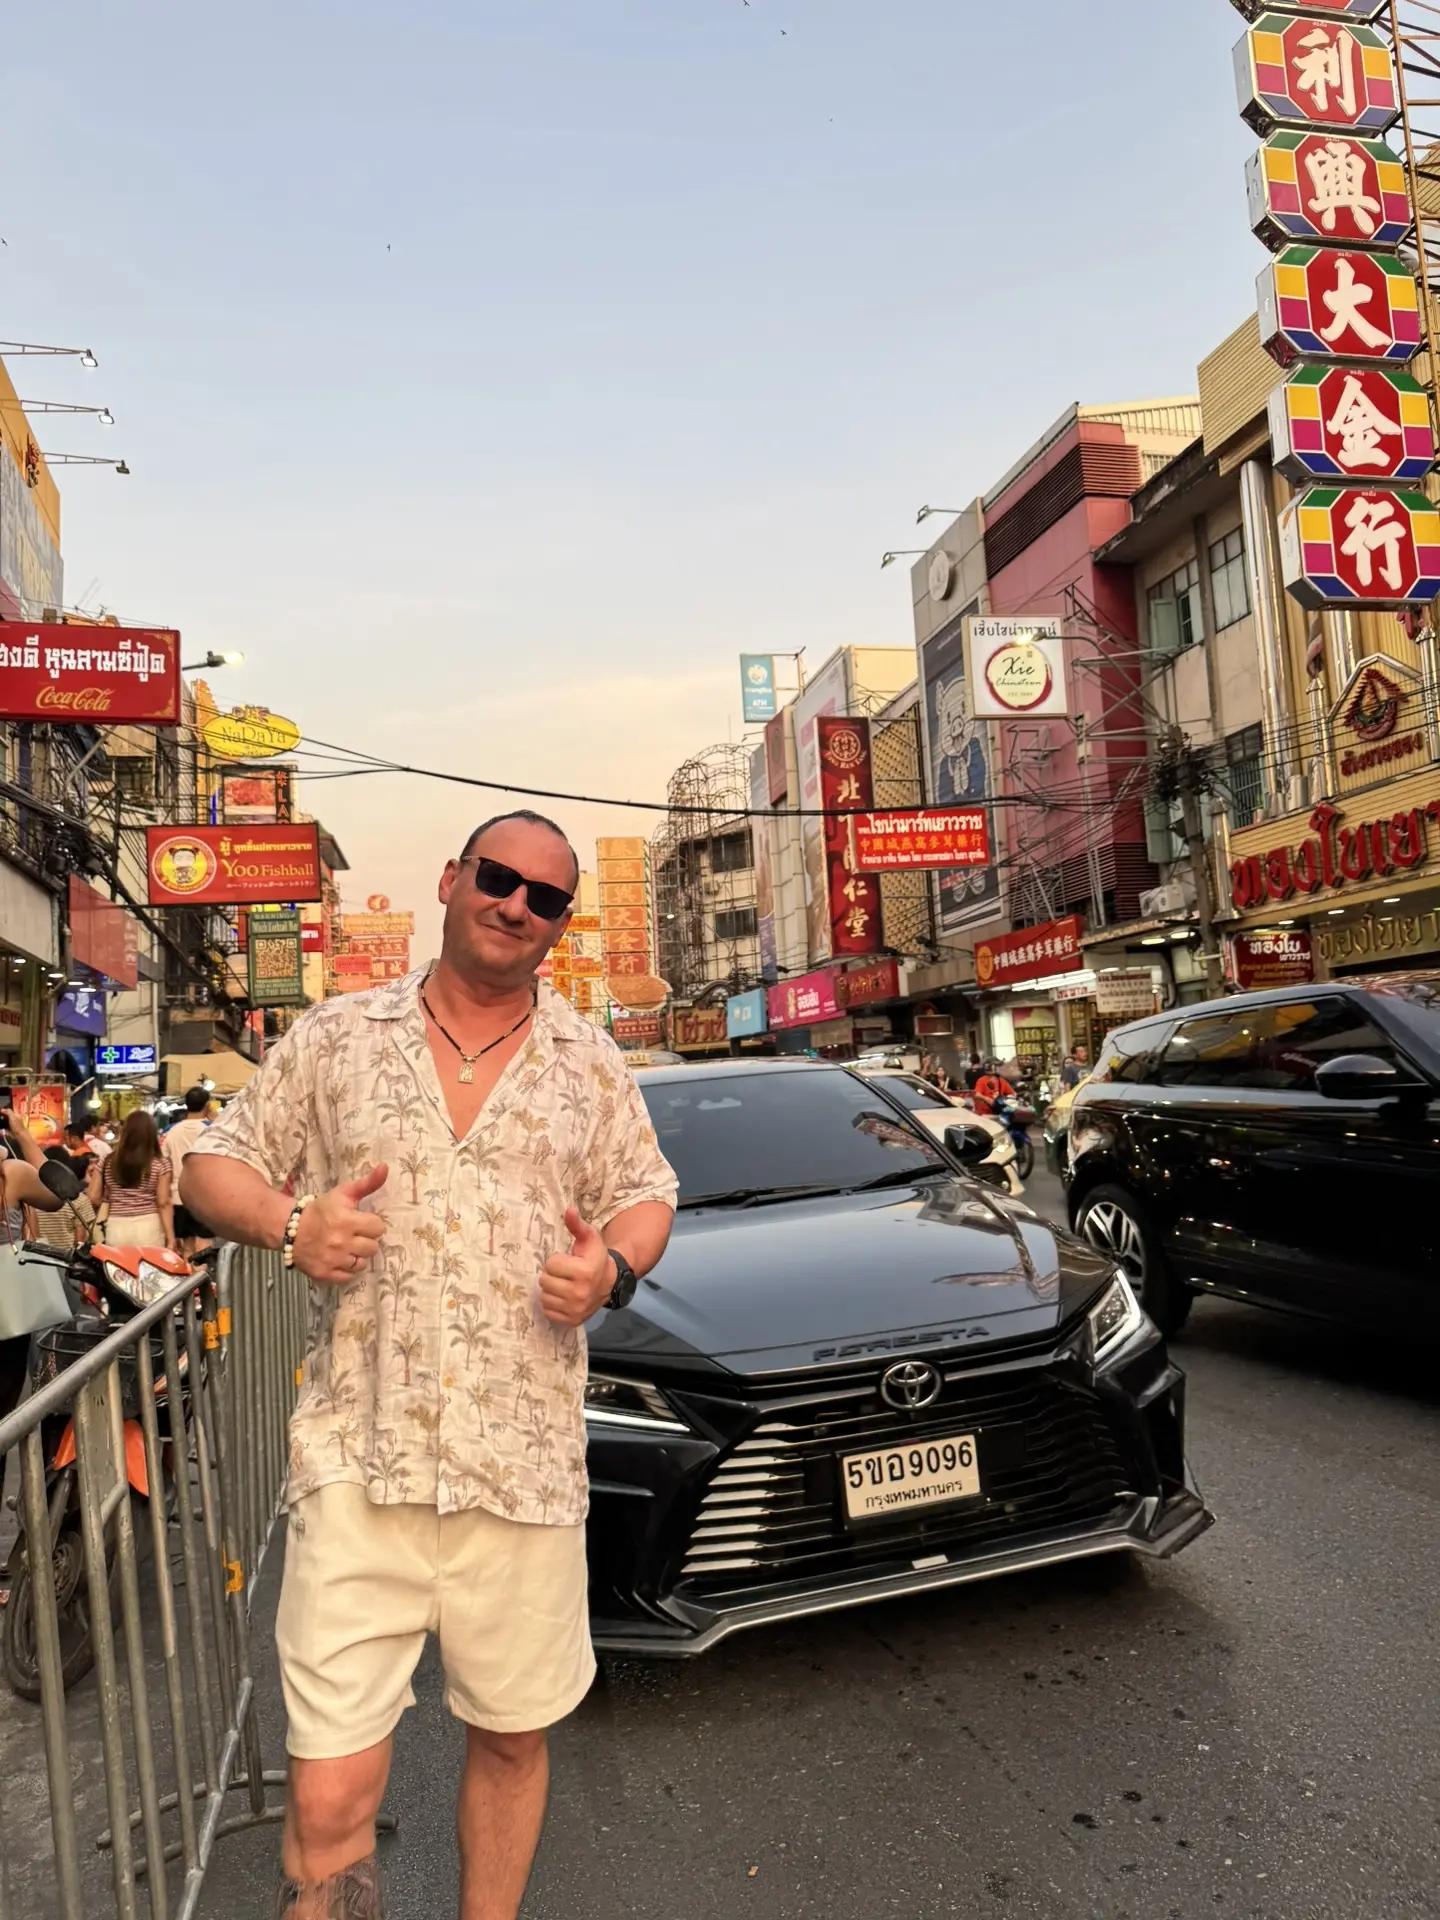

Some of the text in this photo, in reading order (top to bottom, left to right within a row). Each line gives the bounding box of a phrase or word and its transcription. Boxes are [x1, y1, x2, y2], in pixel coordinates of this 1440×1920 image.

[44, 638, 166, 683] หูฉลามซีฟู้ด
[1002, 656, 1036, 676] Xie
[36, 686, 116, 712] Coca-Cola
[261, 863, 314, 877] Fishball
[837, 773, 870, 938] 北仁堂
[1250, 933, 1301, 955] ทองใบ
[908, 1440, 973, 1478] 9096
[865, 1478, 963, 1510] กรุงเทพมหานคร
